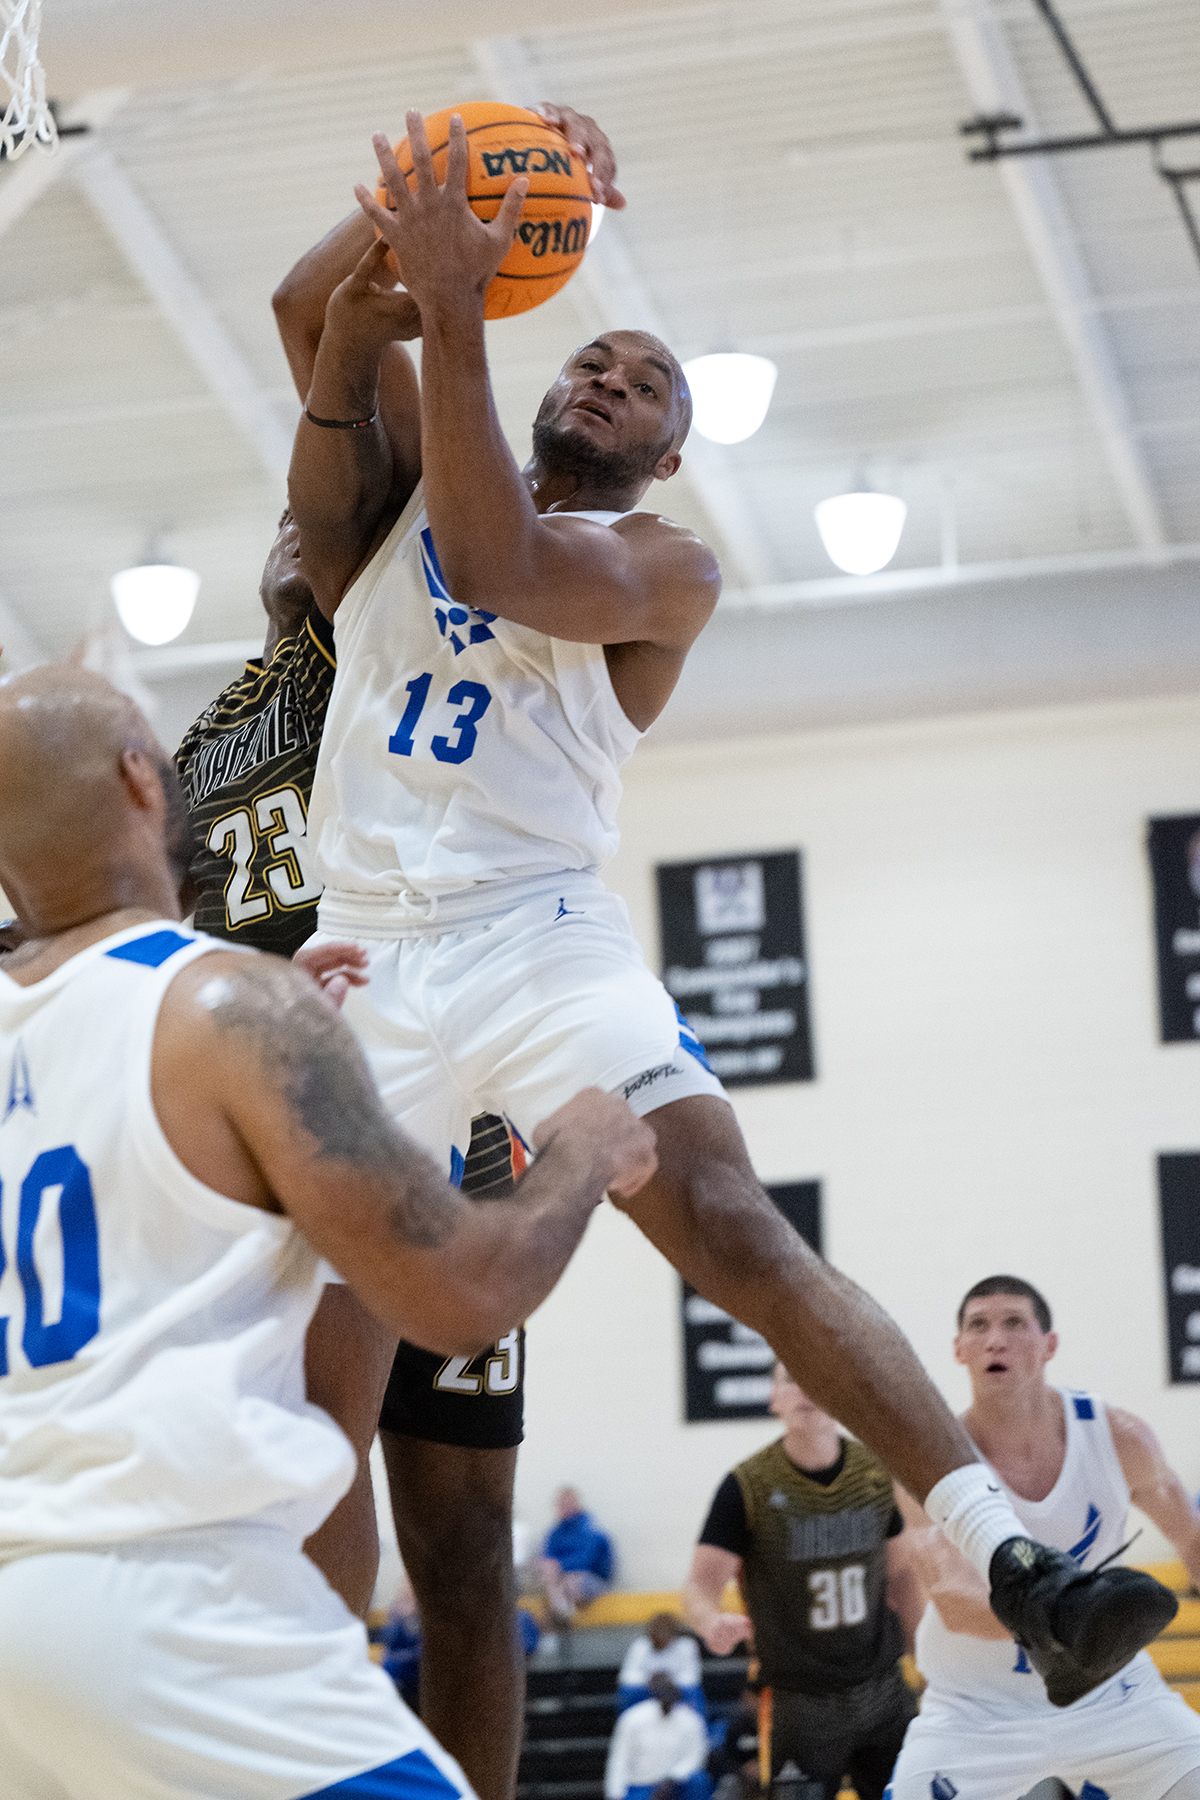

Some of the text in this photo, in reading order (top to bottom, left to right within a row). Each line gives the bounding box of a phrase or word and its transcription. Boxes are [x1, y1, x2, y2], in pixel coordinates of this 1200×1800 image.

[482, 148, 573, 177] NCAA
[514, 216, 588, 257] Wils
[388, 672, 492, 765] 13
[207, 783, 323, 931] 23
[0, 1145, 101, 1376] 0
